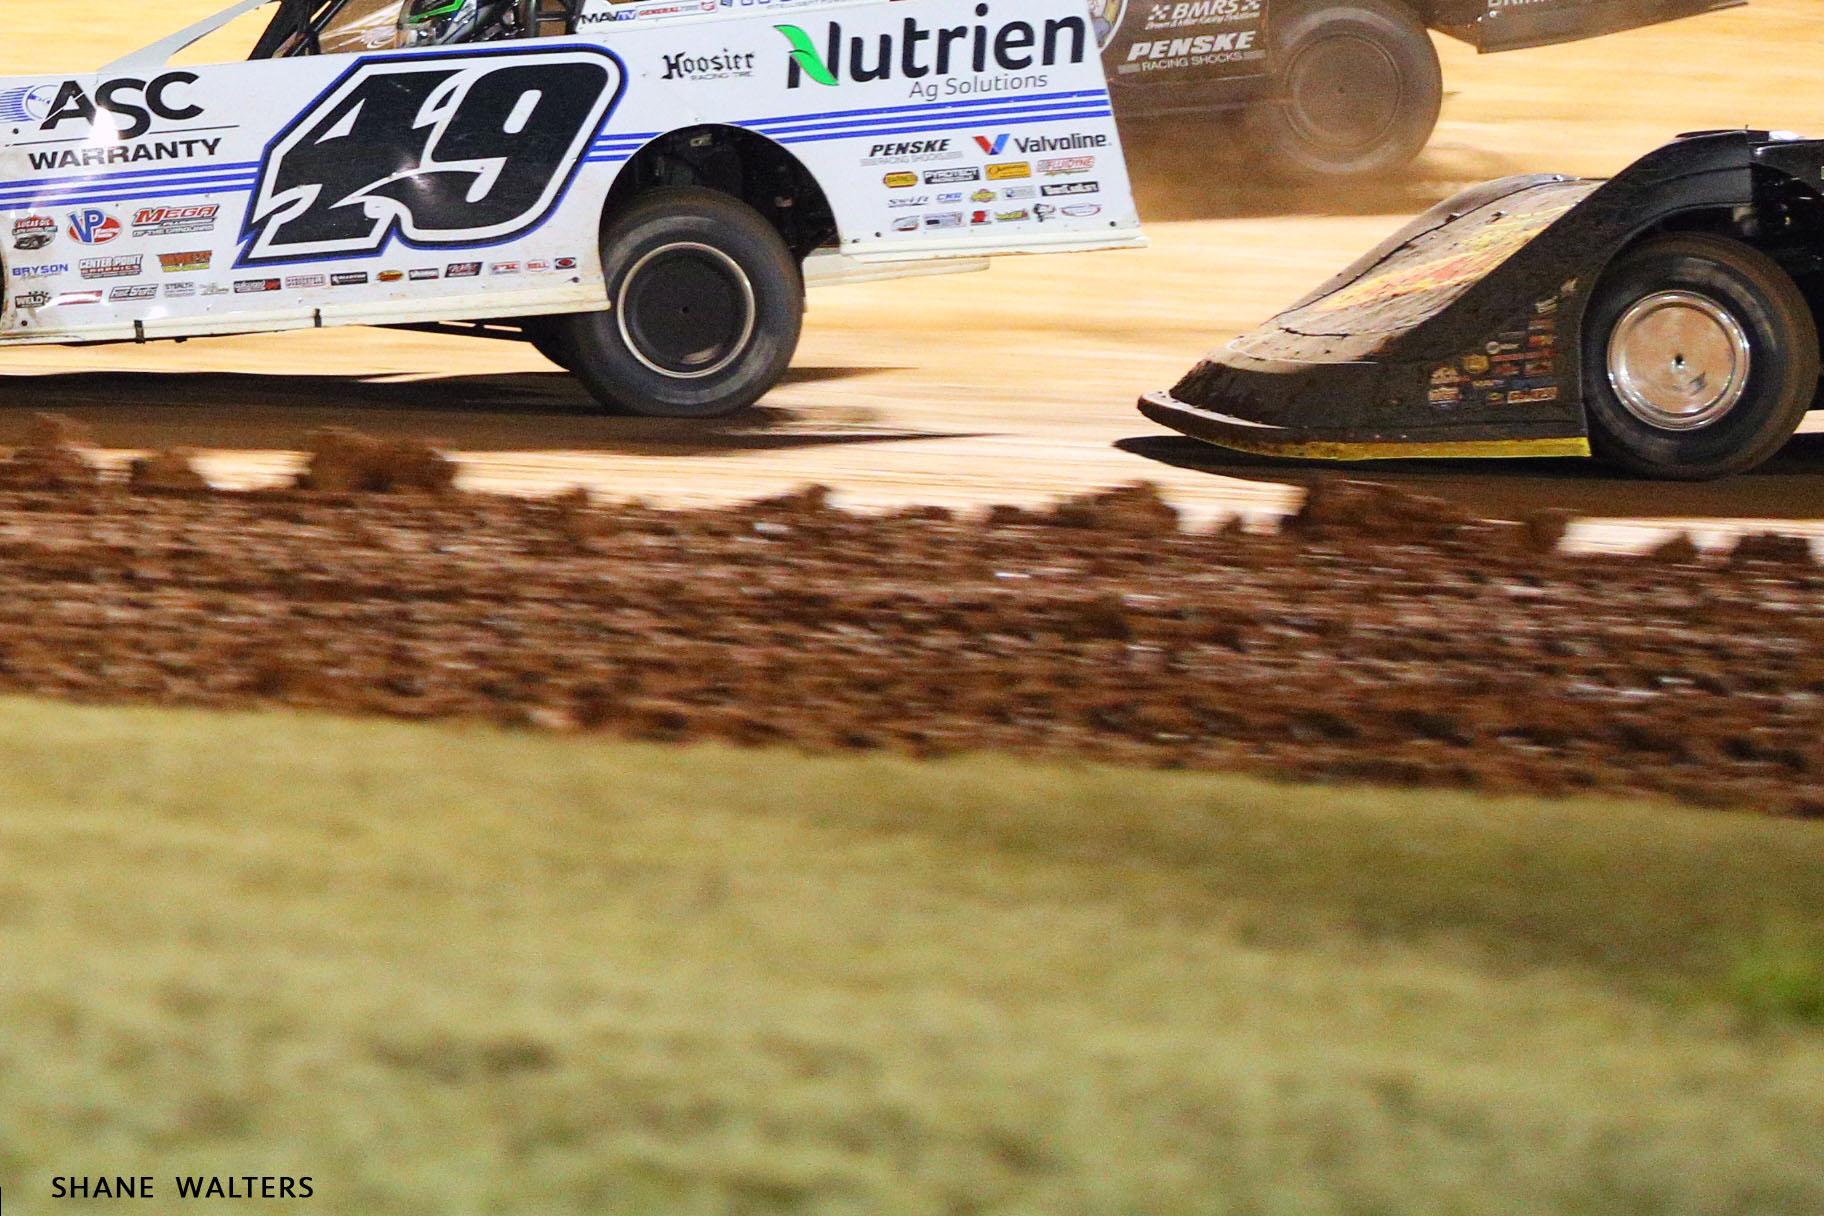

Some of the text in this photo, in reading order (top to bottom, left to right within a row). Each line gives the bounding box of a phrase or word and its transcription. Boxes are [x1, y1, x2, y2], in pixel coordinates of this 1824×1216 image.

[773, 3, 1087, 89] Nutrien
[1127, 31, 1256, 61] PENSKE
[1142, 51, 1243, 71] RACING SHOCKS
[661, 48, 754, 80] Hoosier
[909, 72, 1048, 101] Ag Solutions
[39, 71, 205, 140] ASC
[29, 137, 222, 171] WARRANTY
[261, 61, 609, 247] 49
[869, 138, 952, 157] PENSKE
[1014, 132, 1107, 153] Valvoline
[69, 209, 105, 243] VP
[135, 206, 215, 223] MEGA
[12, 263, 69, 276] BRYSON
